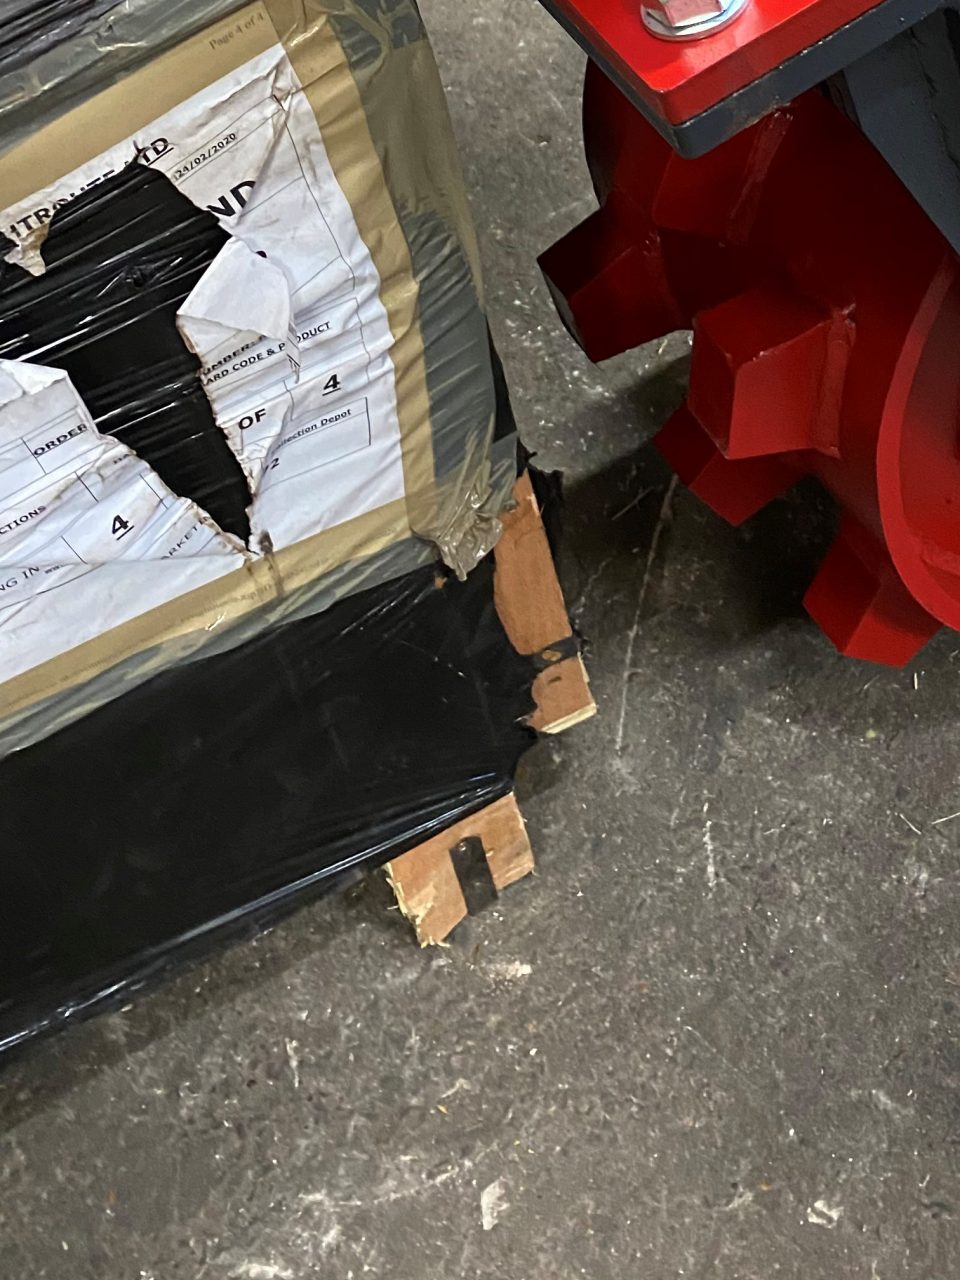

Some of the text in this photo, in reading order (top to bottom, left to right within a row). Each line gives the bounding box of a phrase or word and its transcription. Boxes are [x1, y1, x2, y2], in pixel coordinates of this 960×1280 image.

[232, 351, 264, 372] CODE
[322, 373, 342, 392] 4
[238, 408, 267, 431] OF
[320, 408, 352, 428] Depot
[33, 423, 89, 457] ORDER
[111, 514, 130, 536] 4
[22, 566, 41, 580] IN
